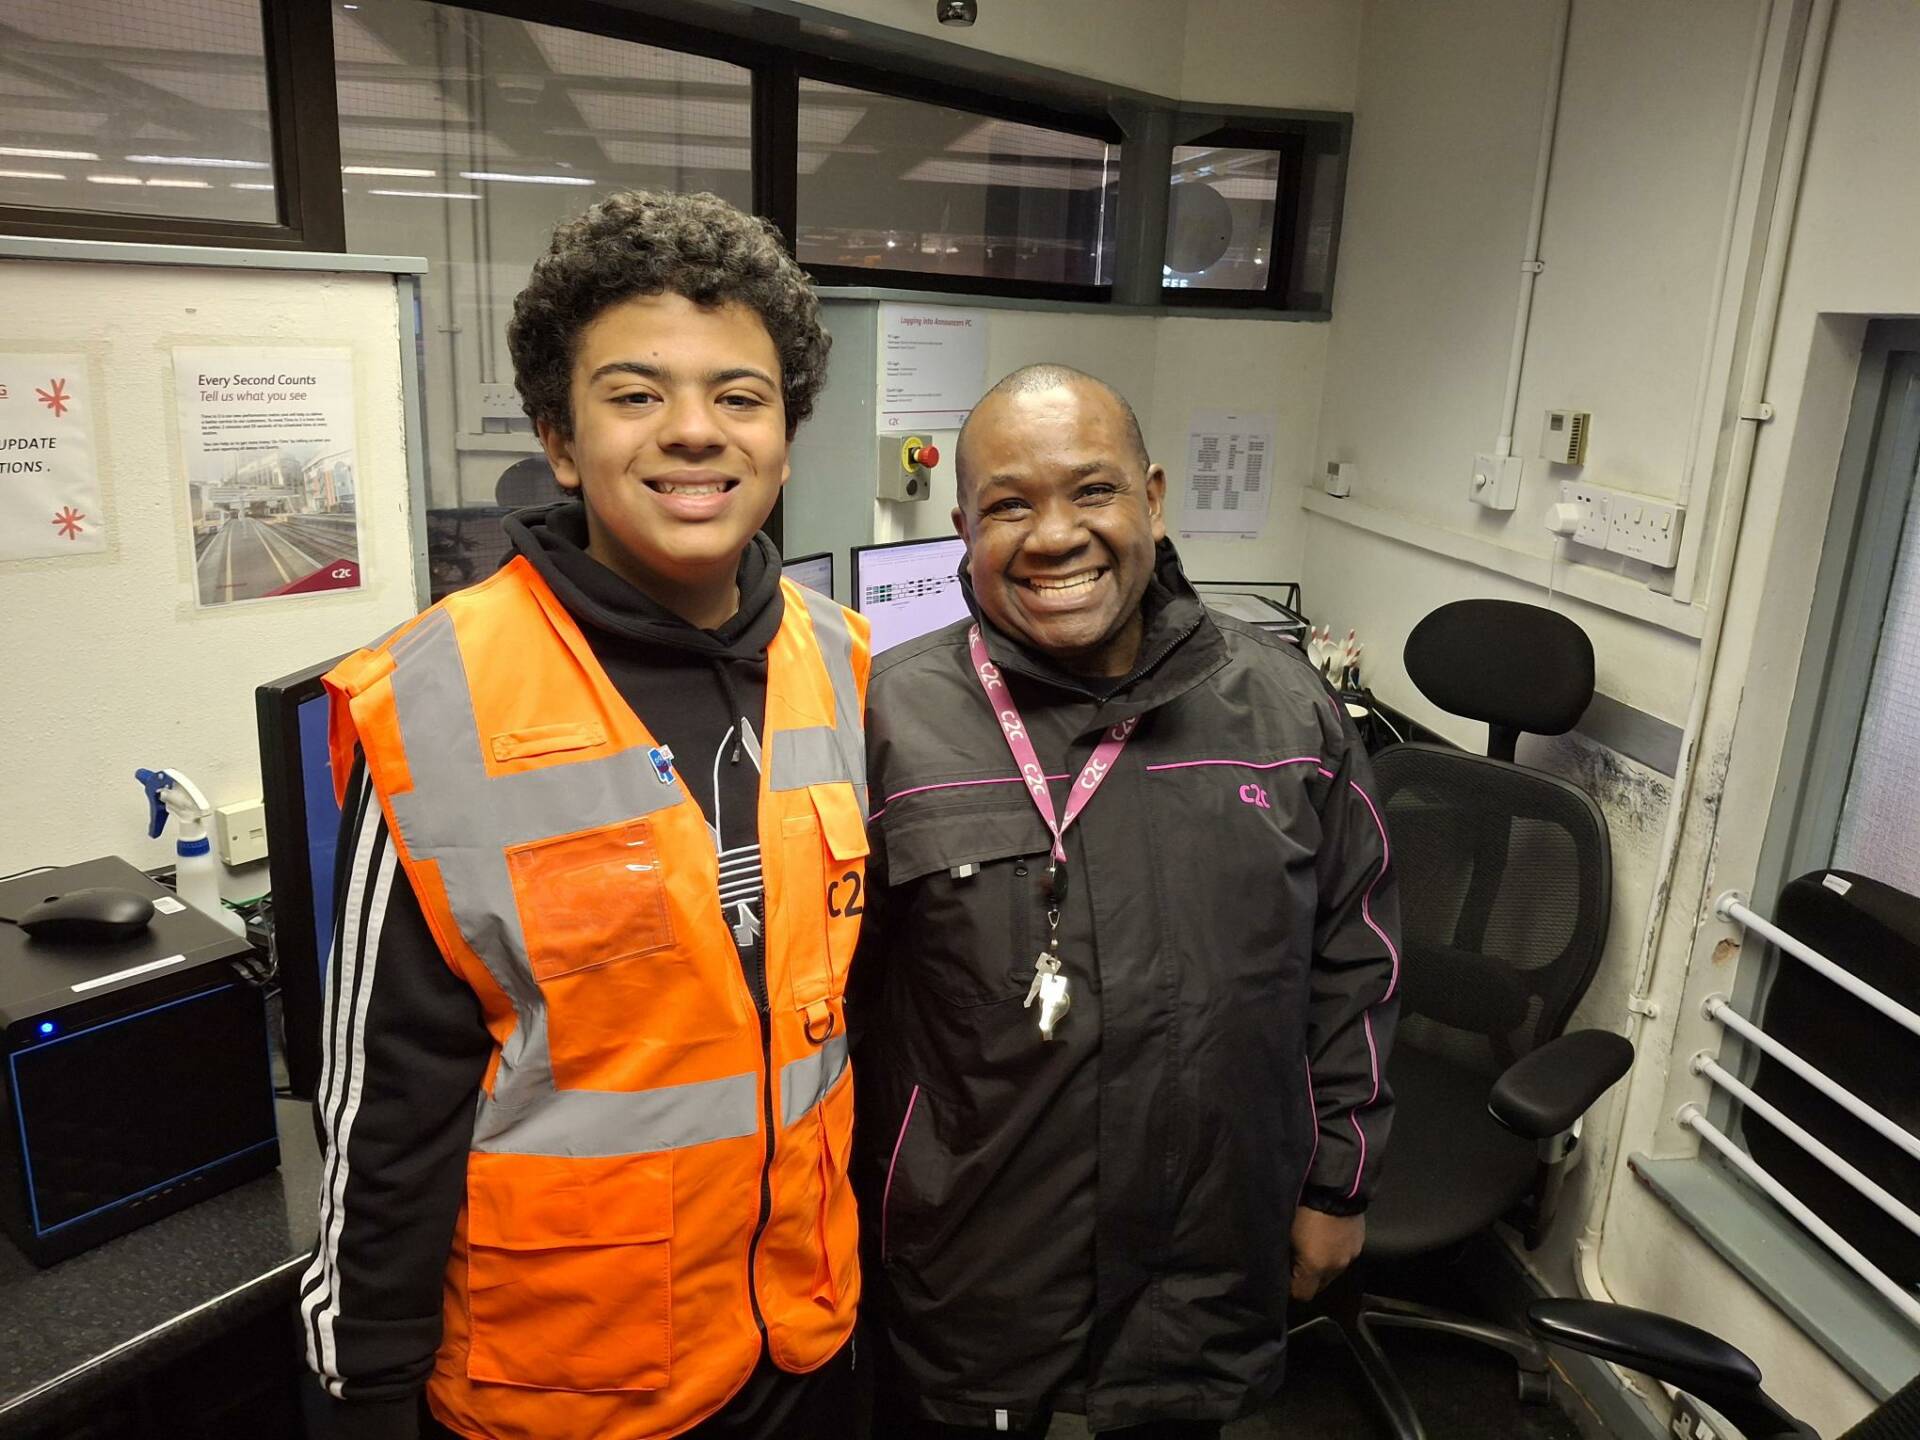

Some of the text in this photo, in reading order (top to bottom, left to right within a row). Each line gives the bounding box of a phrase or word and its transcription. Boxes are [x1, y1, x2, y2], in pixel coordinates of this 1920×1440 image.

[198, 374, 316, 388] Every Second Counts
[200, 390, 307, 404] Tell us what you see
